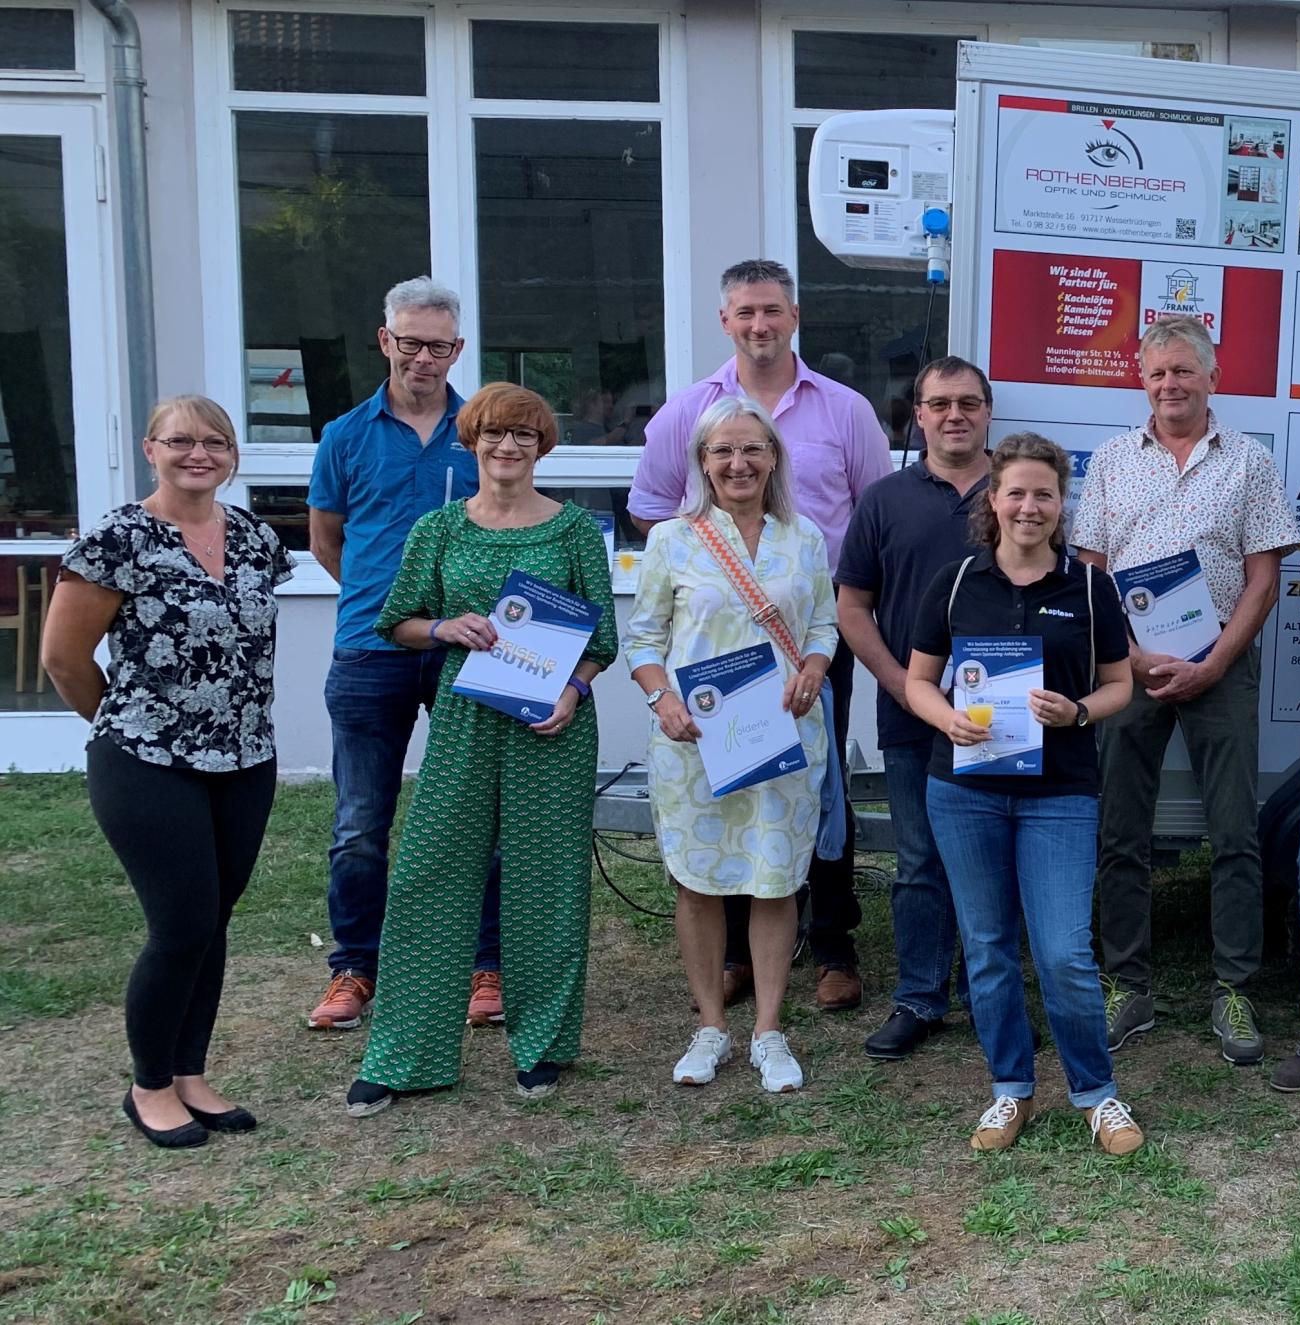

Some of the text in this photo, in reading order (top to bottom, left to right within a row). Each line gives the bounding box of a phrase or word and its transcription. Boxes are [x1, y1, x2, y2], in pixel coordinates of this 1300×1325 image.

[1071, 104, 1220, 124] BRILLEN KONTAKTLINSEN SCHMUCK UHREN
[1026, 168, 1186, 192] ROTHENBERGER
[1044, 186, 1167, 202] OPTIK UND SCHMUCK
[1023, 209, 1064, 220] Marktstraße
[1065, 212, 1075, 221] 16
[1080, 213, 1104, 223] 91717
[1049, 265, 1108, 279] Wir sind Ihr
[1058, 277, 1118, 291] Partner für:
[1064, 294, 1114, 306] Kachelöfen
[1063, 304, 1113, 317] Kaminöfen
[1166, 303, 1195, 312] FRANK
[1063, 315, 1109, 327] Pelletöfen
[1063, 326, 1093, 336] Fliesen
[1046, 346, 1088, 358] Munninger
[1090, 349, 1103, 358] Str.
[1103, 350, 1112, 358] 12
[1046, 356, 1074, 365] Telefon
[1081, 358, 1093, 366] 90
[1093, 359, 1103, 367] 82
[1110, 360, 1118, 368] 14
[1119, 360, 1129, 369] 92
[1045, 365, 1125, 377] info@ofen-bittner.de
[490, 647, 555, 680] GUTHY
